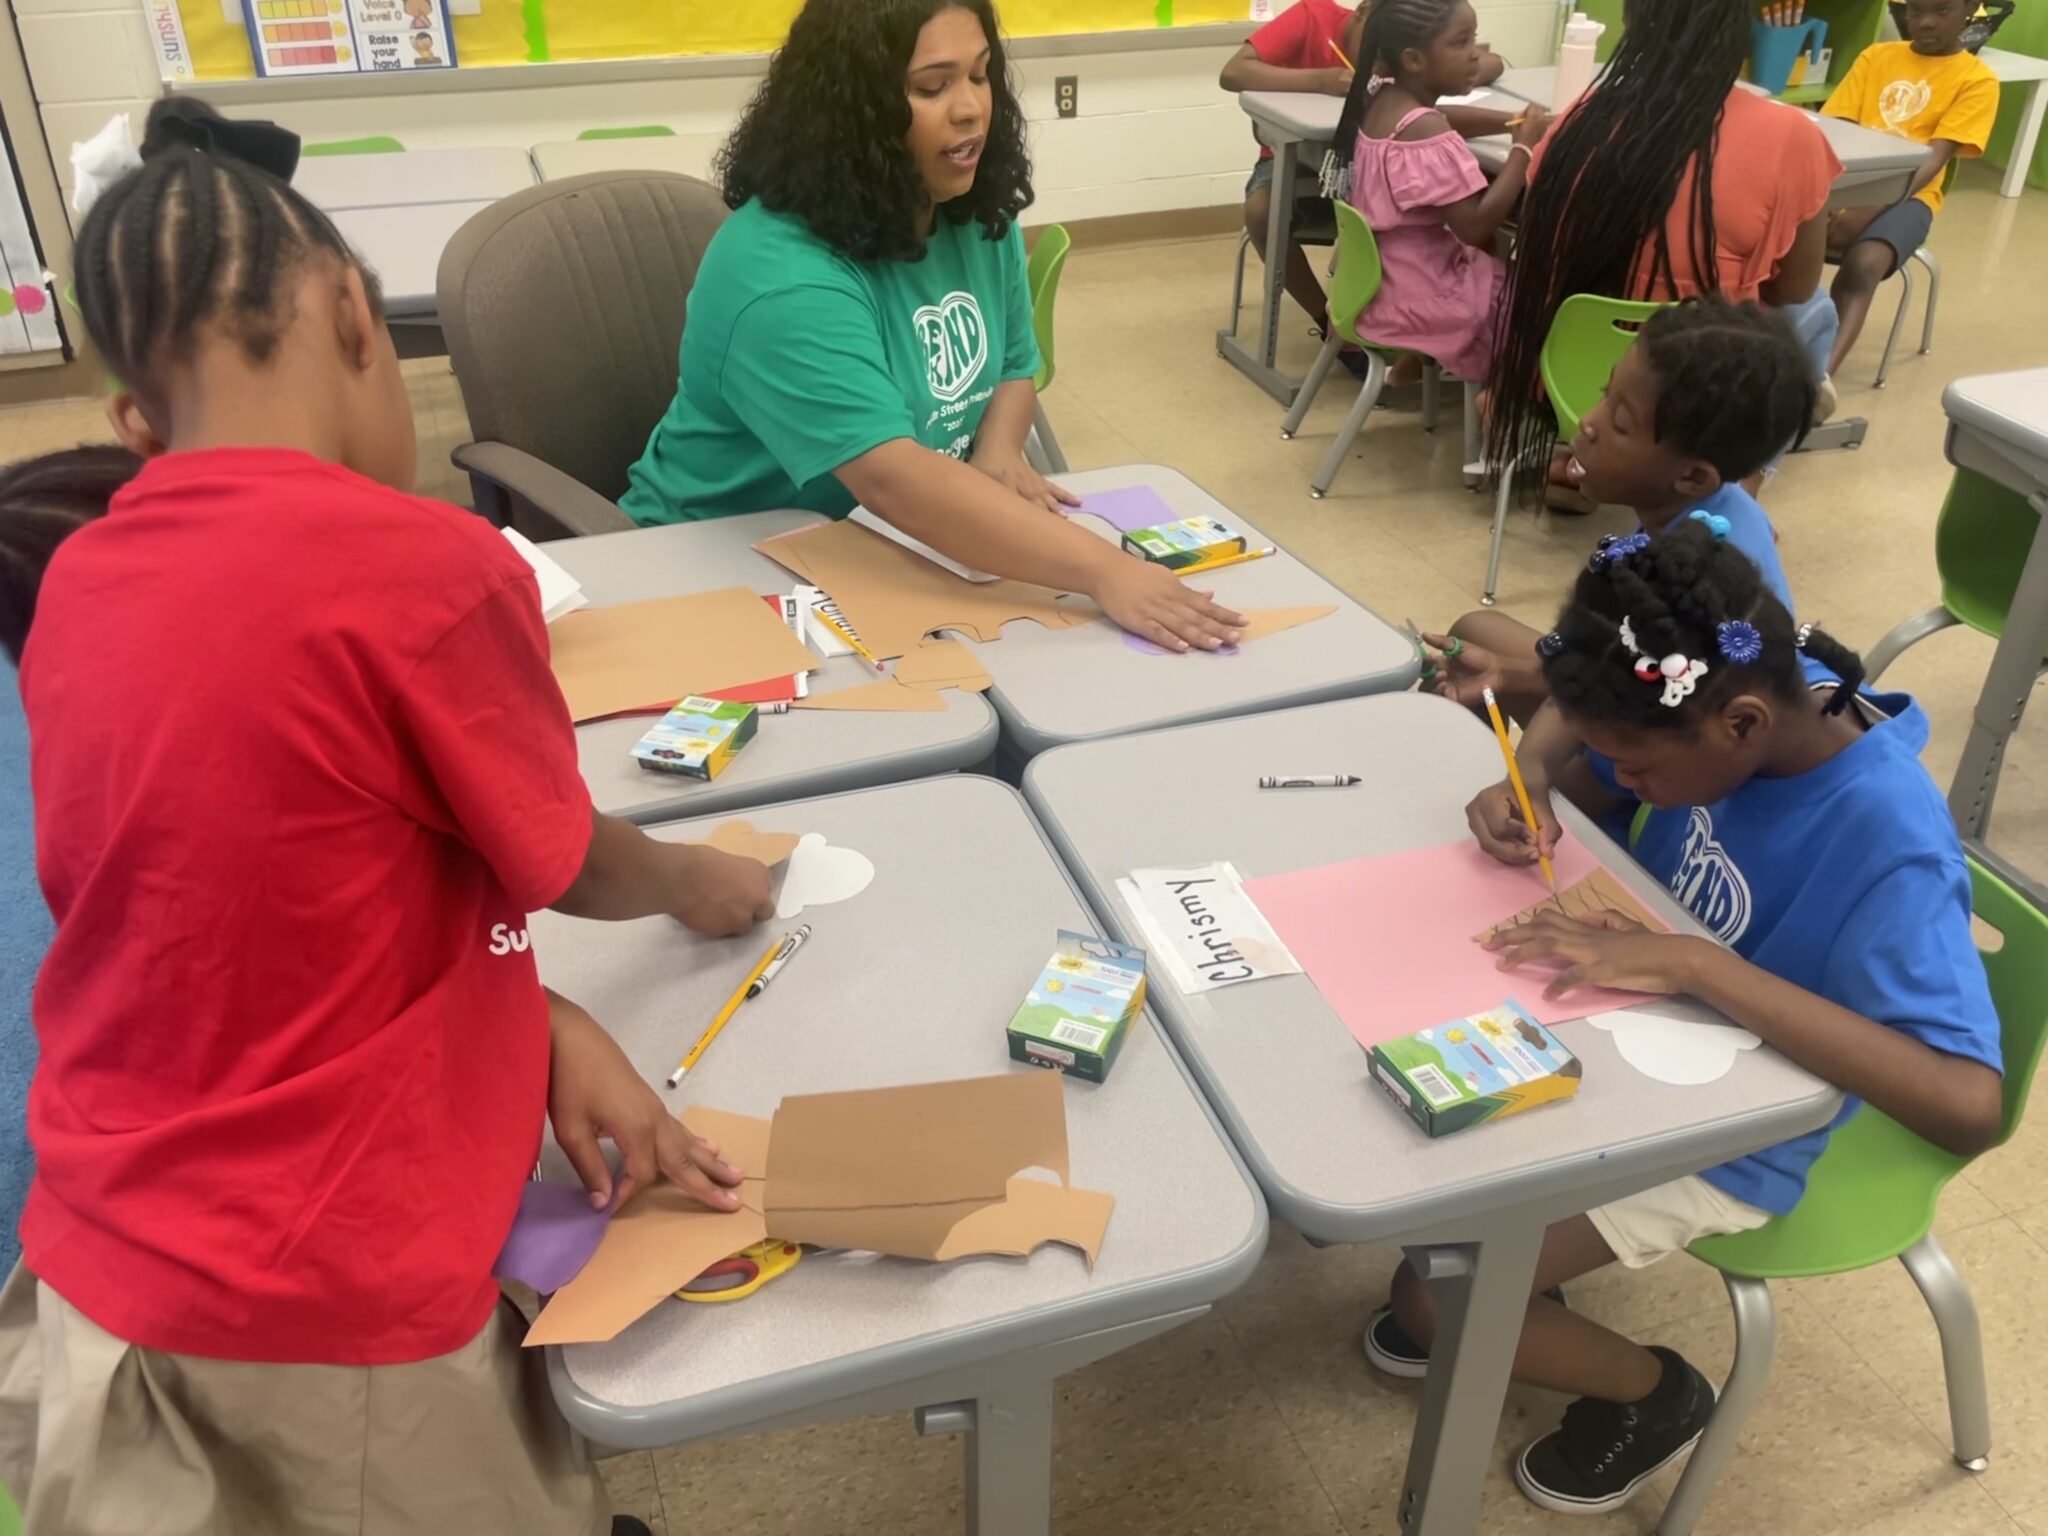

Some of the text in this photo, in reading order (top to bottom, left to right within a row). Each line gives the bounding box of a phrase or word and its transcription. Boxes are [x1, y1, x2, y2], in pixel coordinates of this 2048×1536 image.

[359, 10, 392, 23] Level
[368, 34, 399, 46] Raise
[371, 47, 398, 58] your
[372, 58, 401, 71] hand
[939, 398, 969, 418] Street
[1165, 878, 1254, 982] Chrismy
